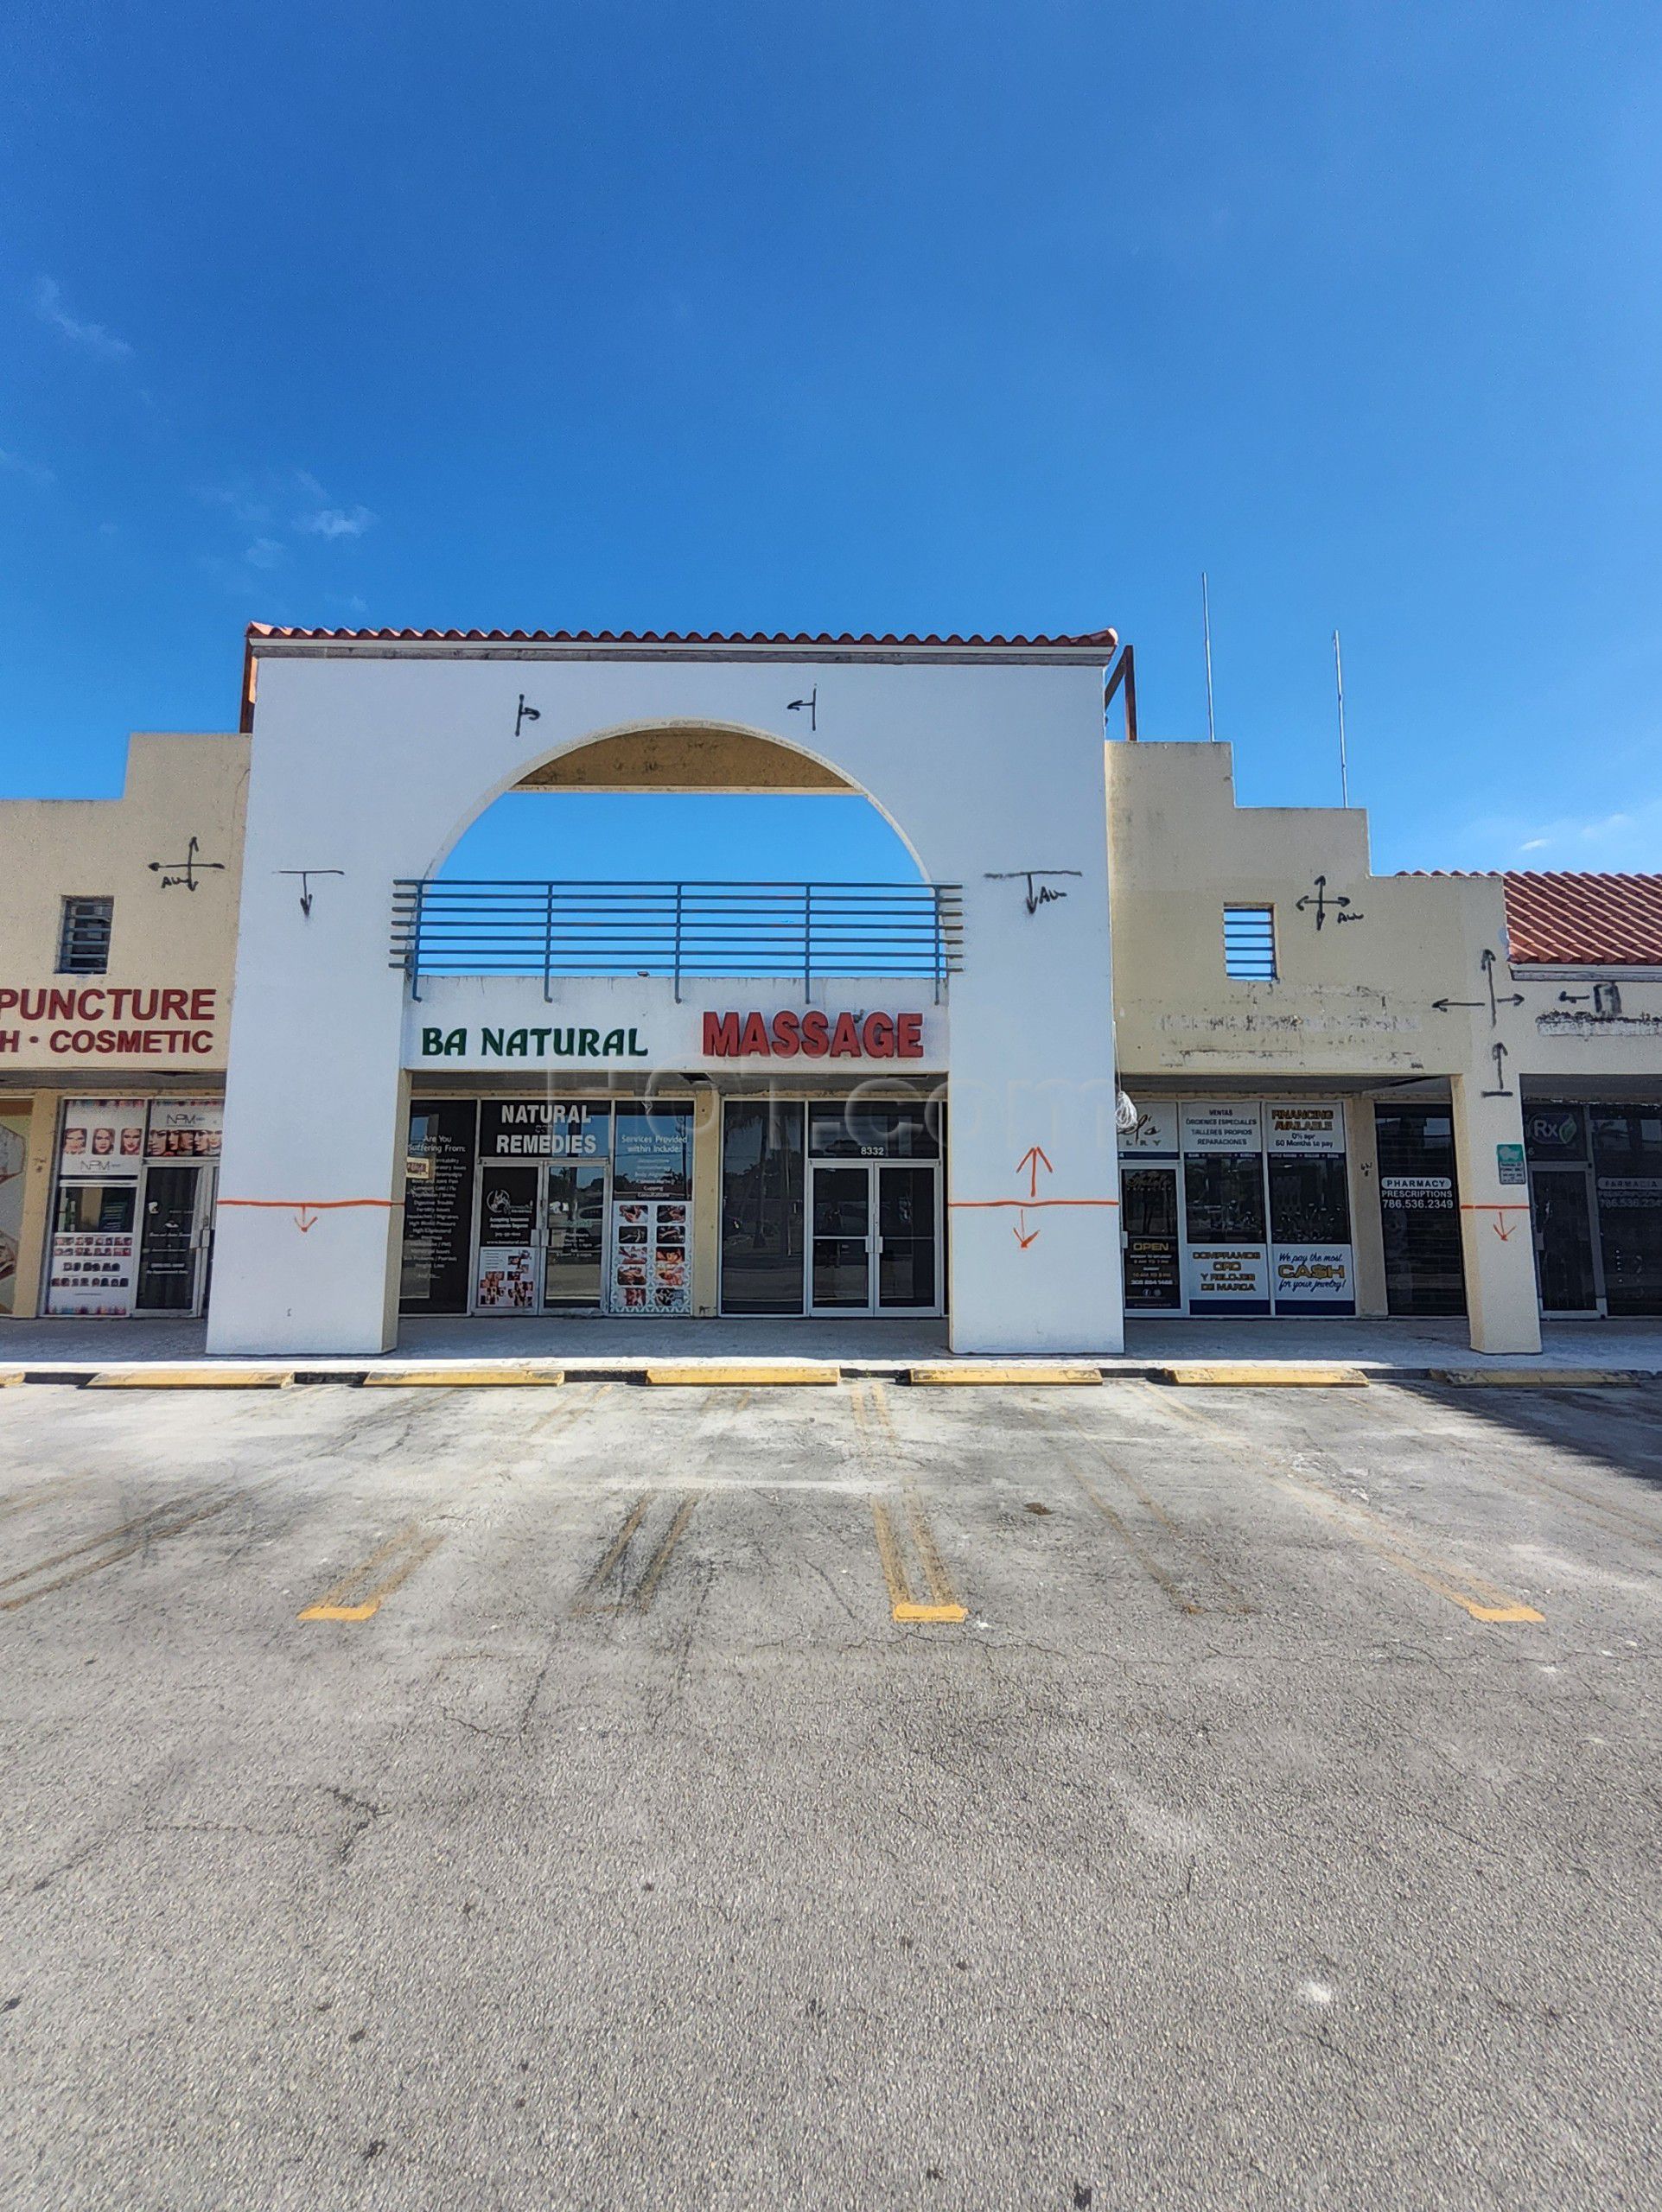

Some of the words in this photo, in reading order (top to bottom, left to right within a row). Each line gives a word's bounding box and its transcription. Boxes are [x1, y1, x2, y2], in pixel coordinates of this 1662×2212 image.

[0, 989, 216, 1020] PUNCTURE
[49, 1030, 213, 1053] COSMETIC
[422, 1027, 468, 1056] BA
[481, 1027, 649, 1057] NATURAL
[703, 1010, 924, 1058] MASSAGE
[501, 1104, 591, 1123] NATURAL
[496, 1135, 596, 1154] REMEDIES
[621, 1135, 653, 1143] Services
[655, 1135, 688, 1143] Provided
[861, 1146, 884, 1155] 8332
[1383, 1199, 1454, 1209] 786.536.2349
[1133, 1243, 1168, 1251] OPEN
